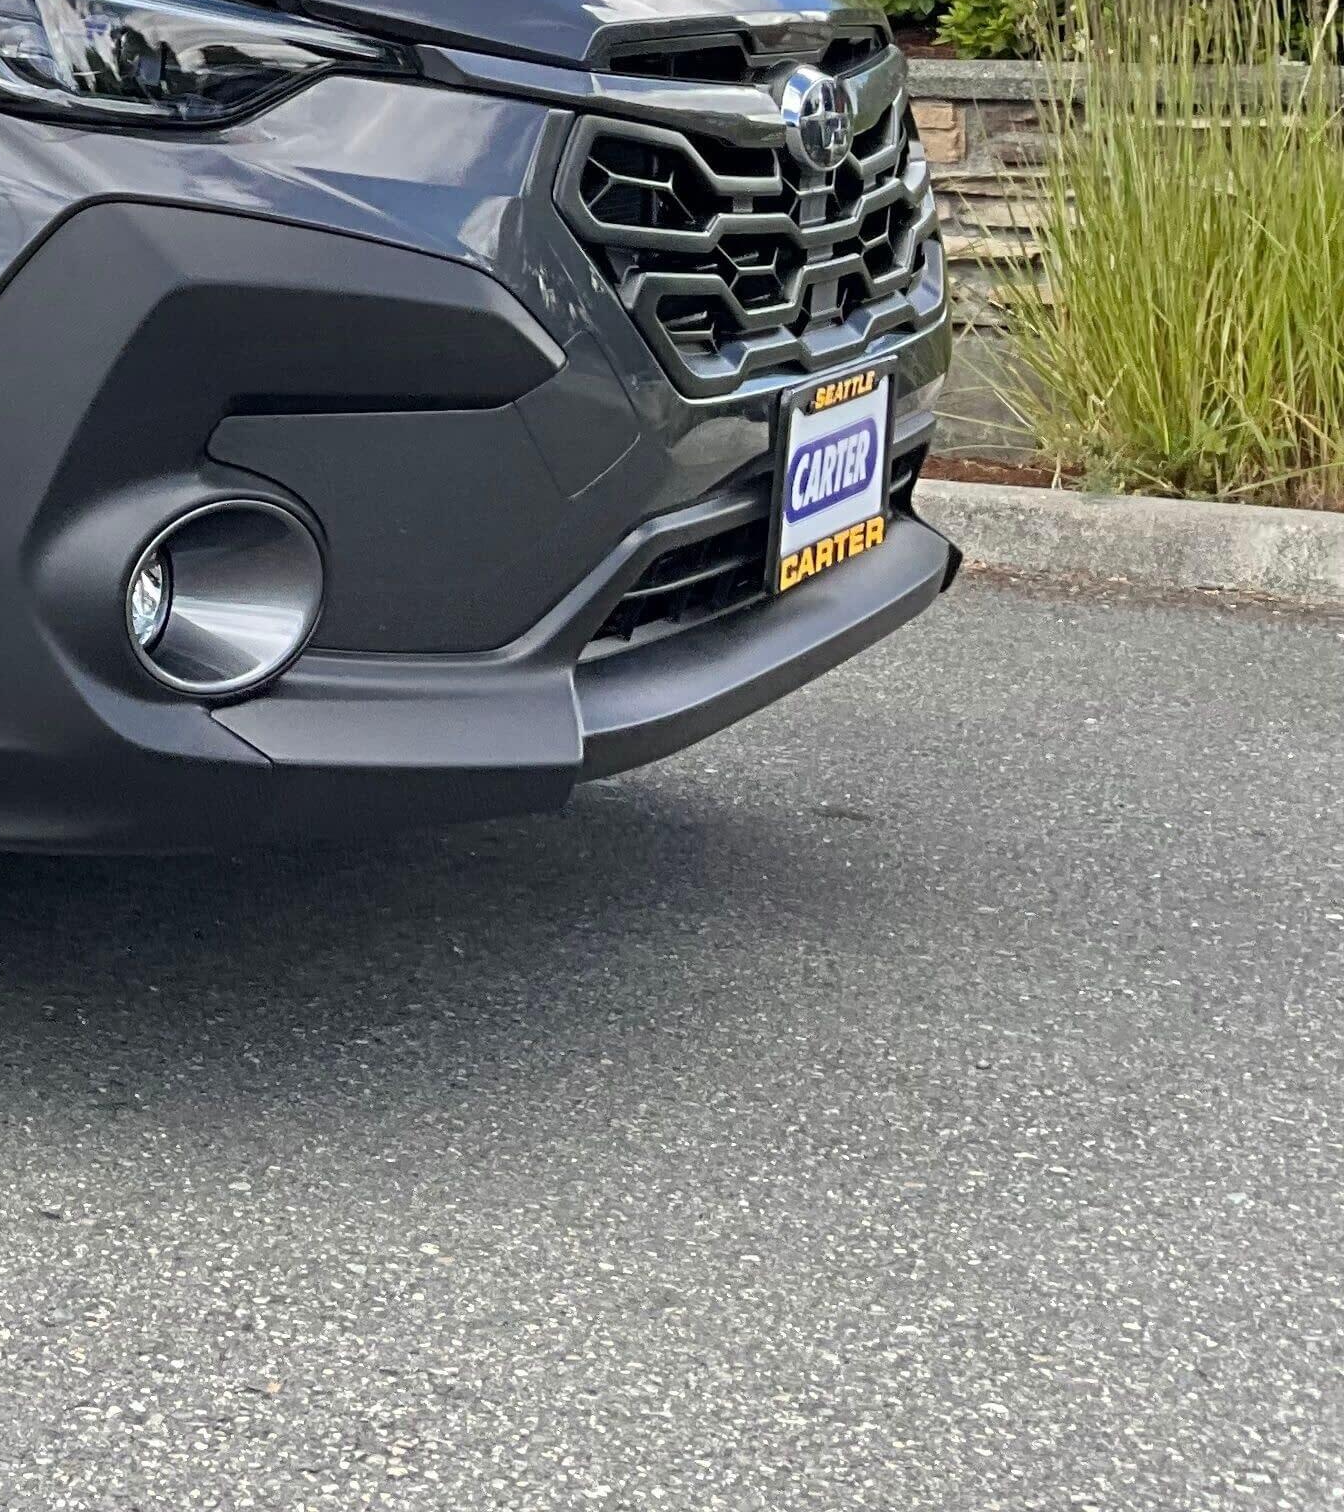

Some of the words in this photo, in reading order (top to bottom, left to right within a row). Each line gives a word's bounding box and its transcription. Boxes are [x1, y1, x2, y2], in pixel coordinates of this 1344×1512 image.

[815, 370, 876, 410] SEATTLE
[791, 429, 871, 511] CARTER
[780, 516, 885, 592] CARTER
